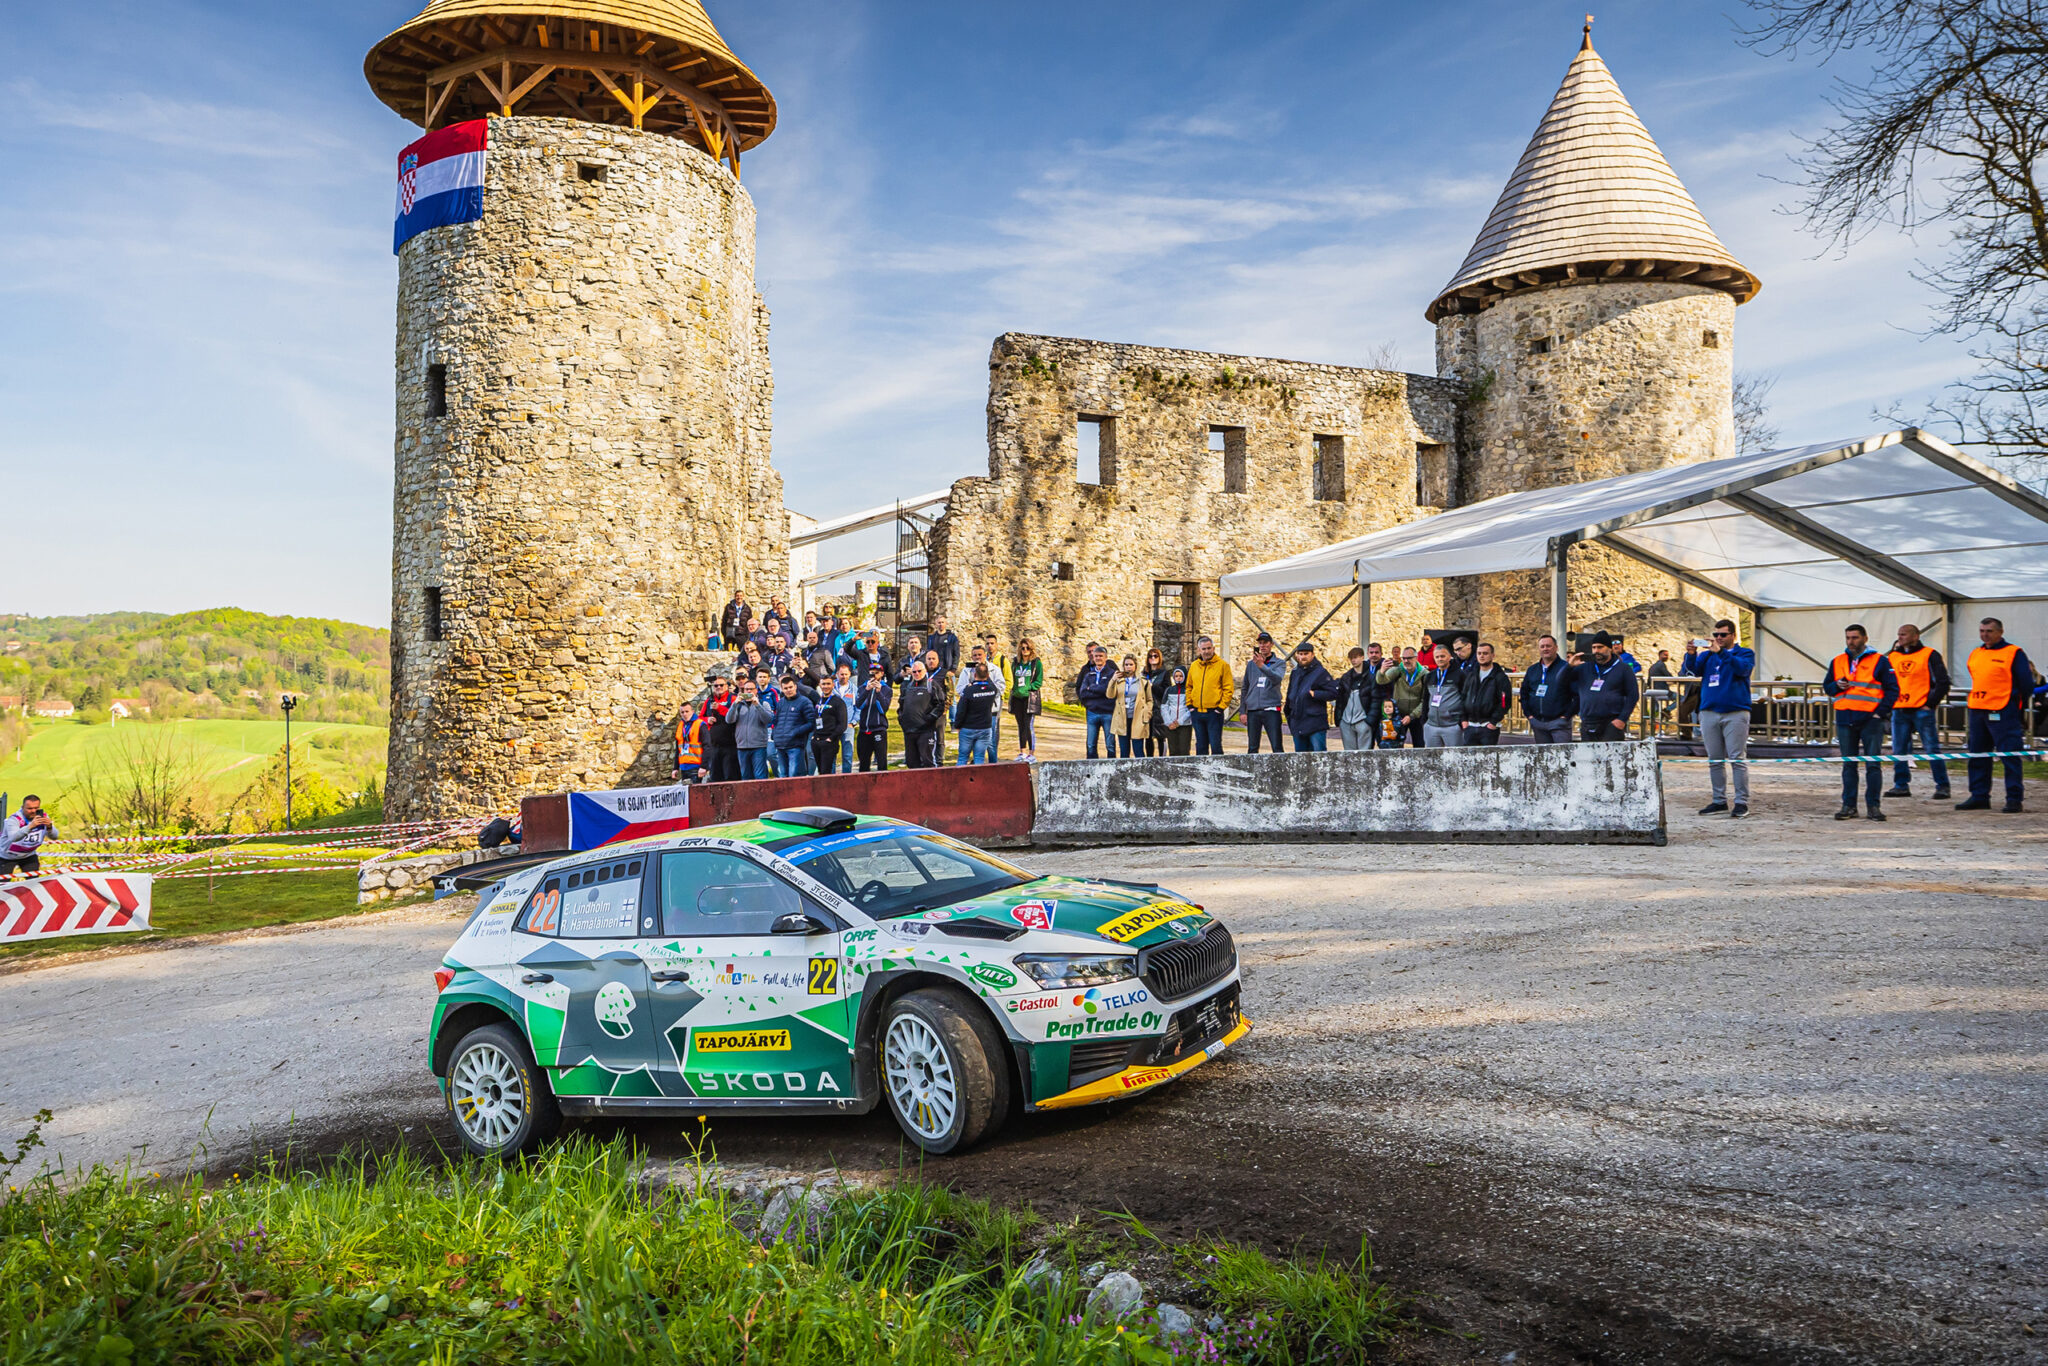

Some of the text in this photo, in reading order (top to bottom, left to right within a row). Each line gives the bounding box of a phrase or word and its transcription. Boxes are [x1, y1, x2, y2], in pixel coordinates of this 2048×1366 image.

[528, 889, 559, 932] 22
[563, 901, 611, 915] E. Lindholm
[843, 929, 878, 943] ORPE
[715, 972, 758, 985] CROATIA
[763, 972, 779, 985] Full
[809, 958, 837, 994] 22
[974, 965, 1014, 985] VIITA
[1019, 996, 1059, 1012] Castrol
[1102, 989, 1148, 1011] TELKO
[1141, 1011, 1163, 1030] Oy
[1121, 1068, 1172, 1088] PIRELLI
